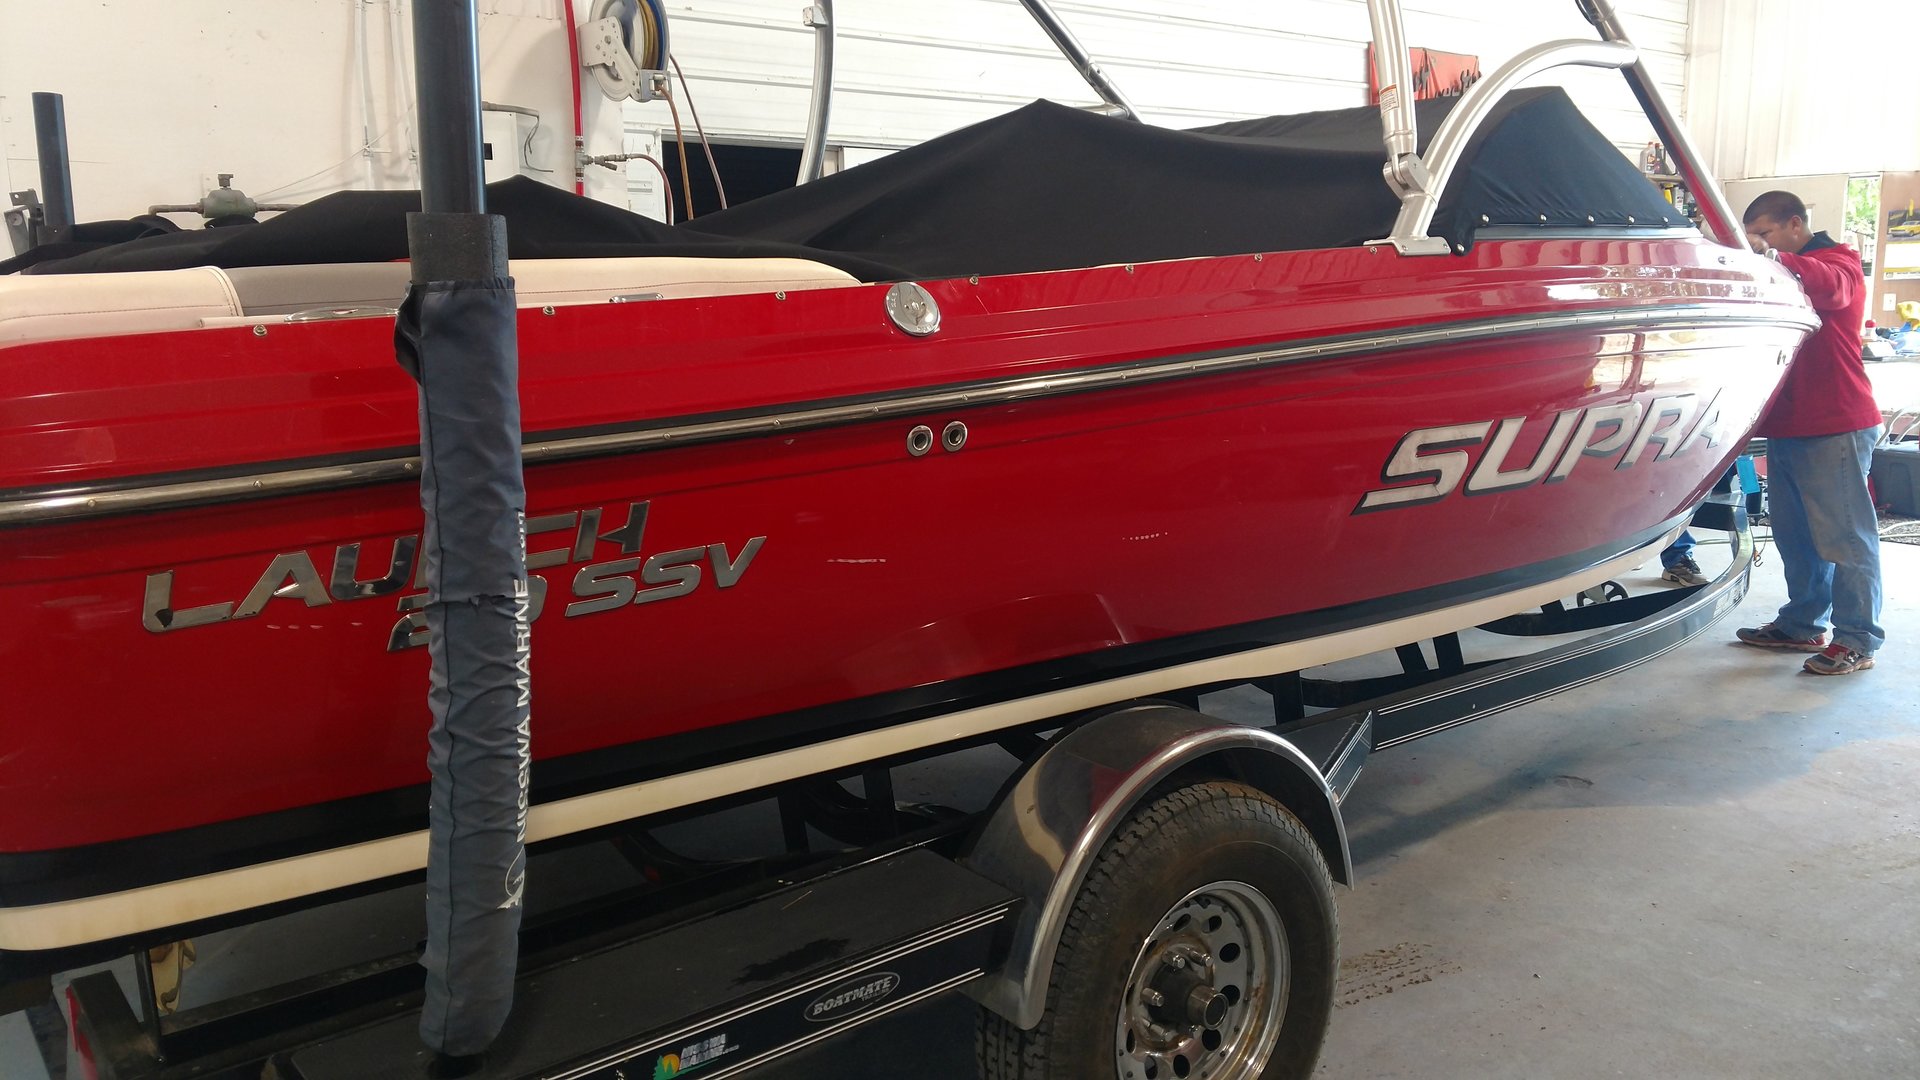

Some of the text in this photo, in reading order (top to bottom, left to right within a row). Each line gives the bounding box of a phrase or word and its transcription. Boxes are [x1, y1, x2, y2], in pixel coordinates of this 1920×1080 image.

[1349, 386, 1729, 516] SUPRA
[142, 500, 651, 634] LAUCH
[564, 536, 767, 618] SSV
[514, 579, 532, 708] MARINE
[812, 976, 893, 1016] BOATMATE
